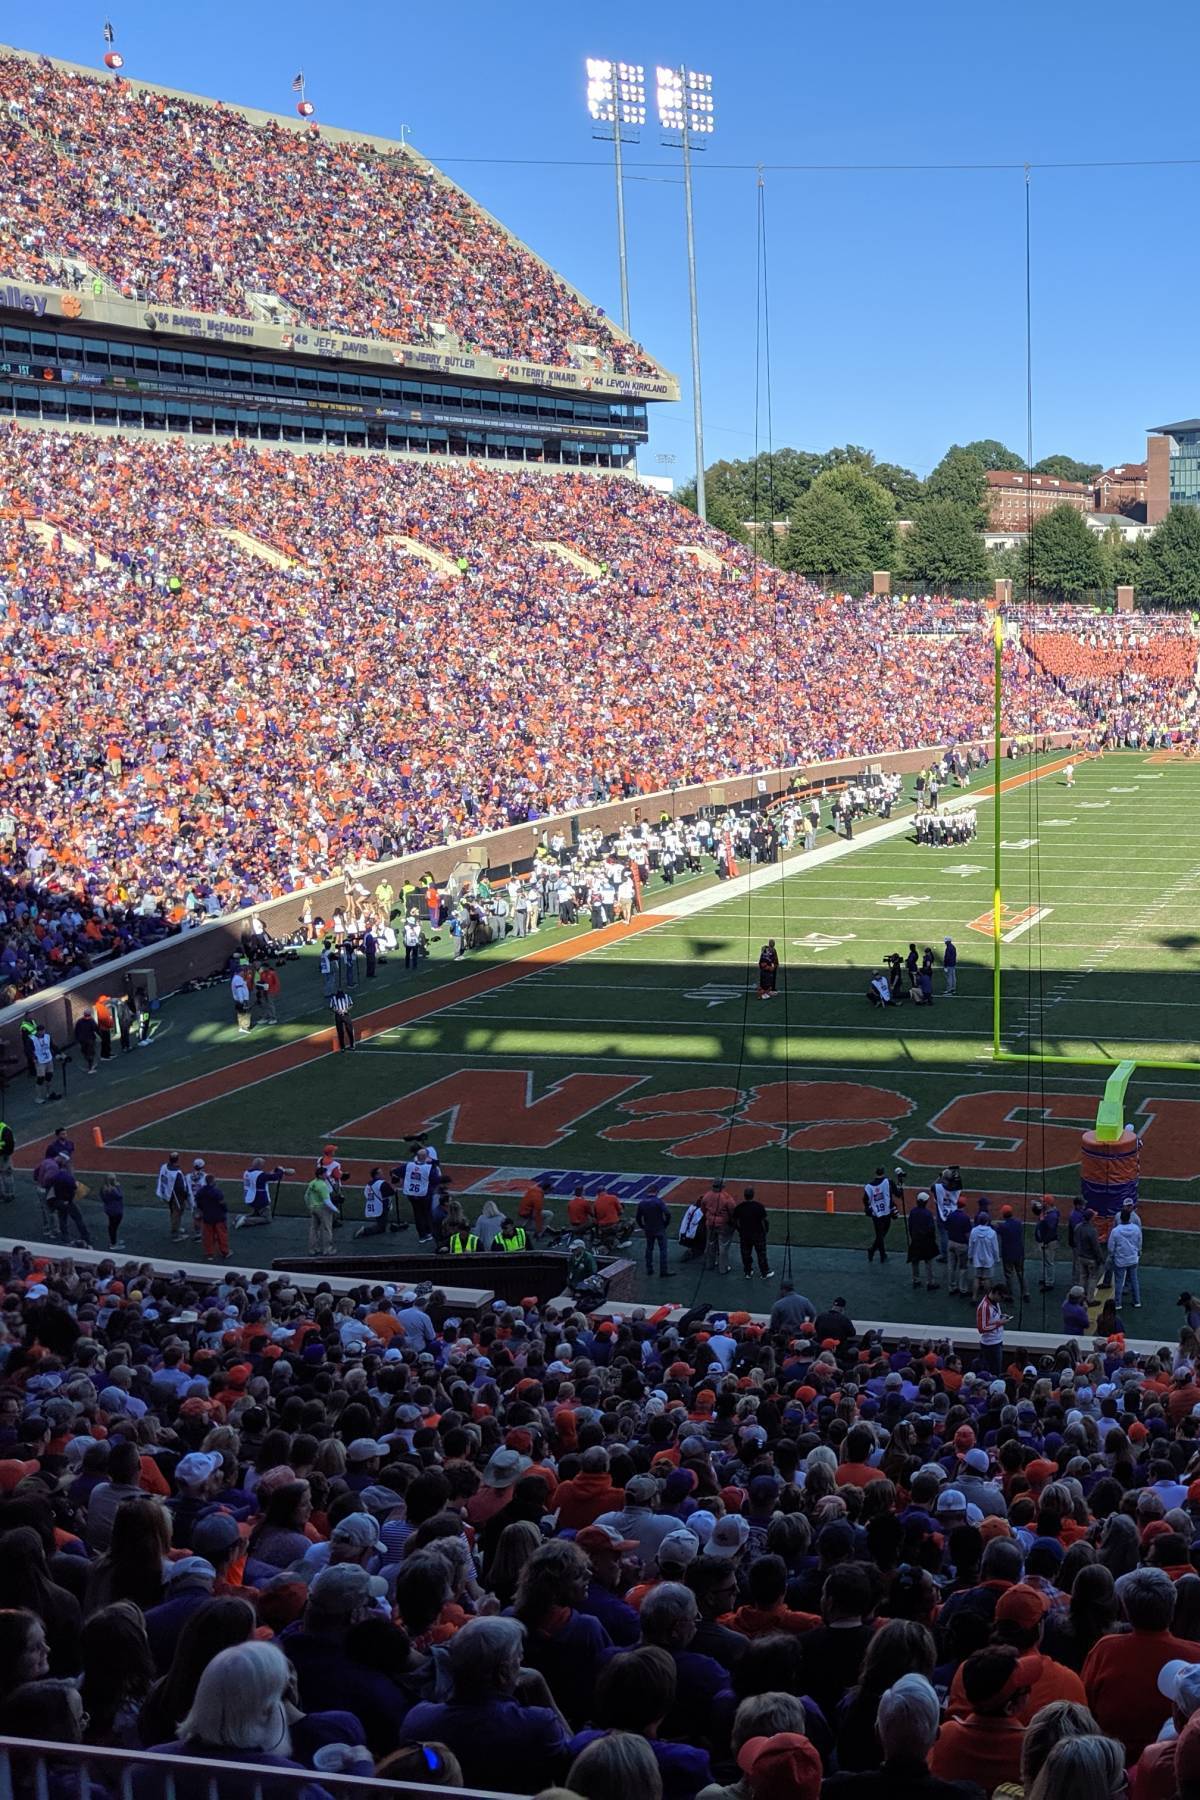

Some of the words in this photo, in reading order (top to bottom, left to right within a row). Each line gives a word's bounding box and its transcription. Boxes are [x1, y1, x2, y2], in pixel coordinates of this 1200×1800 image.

[172, 315, 202, 328] BANKS
[207, 319, 254, 337] McFADDEN
[314, 337, 337, 349] JEFF
[342, 341, 368, 354] DAVIS
[416, 353, 440, 364] JERRY
[445, 356, 475, 369] BUTLER
[18, 365, 29, 375] 1ST
[522, 368, 545, 379] TERRY
[549, 371, 576, 383] KINARD
[606, 379, 630, 389] LEVON
[632, 382, 667, 393] KIRKLAND
[409, 1183, 420, 1193] 26
[876, 1203, 885, 1212] 19
